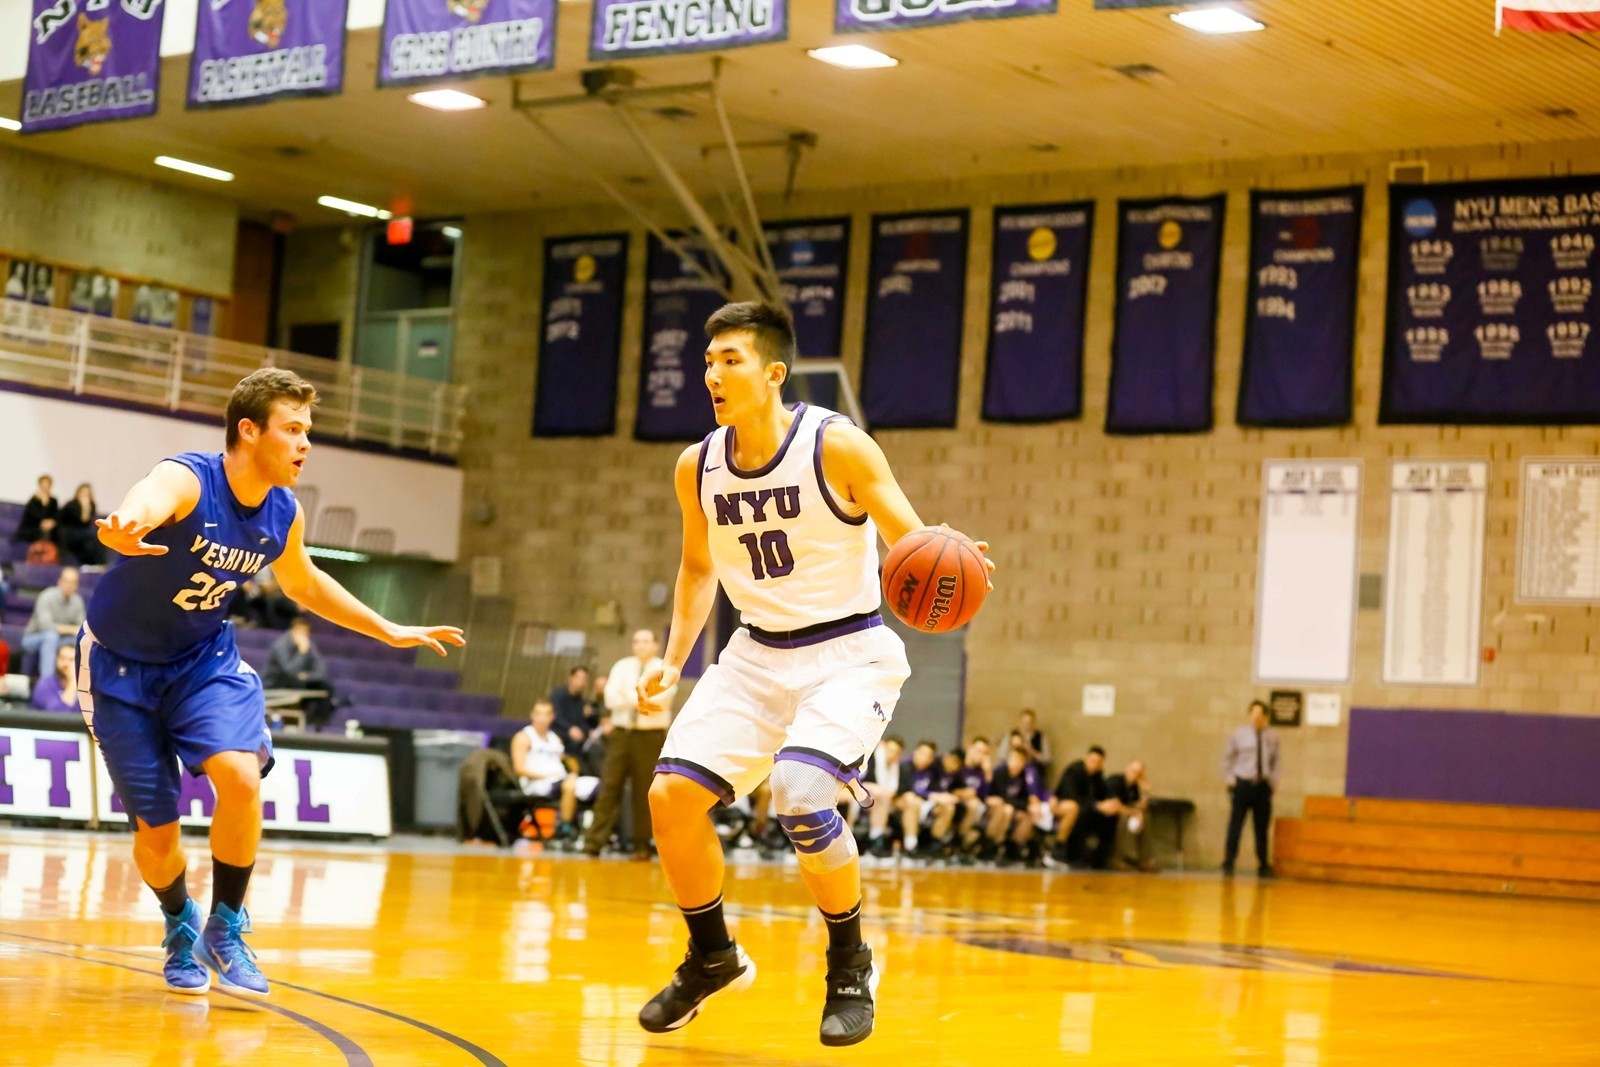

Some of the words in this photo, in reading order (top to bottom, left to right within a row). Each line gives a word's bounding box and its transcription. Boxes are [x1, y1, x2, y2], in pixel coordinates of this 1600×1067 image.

[602, 0, 773, 50] FENCING
[1454, 197, 1495, 218] NYU
[1499, 196, 1559, 216] MEN'S
[713, 485, 801, 526] NYU
[189, 534, 266, 574] YESHIVA
[738, 529, 794, 580] 10
[172, 571, 237, 611] 20
[922, 574, 958, 632] Wilson
